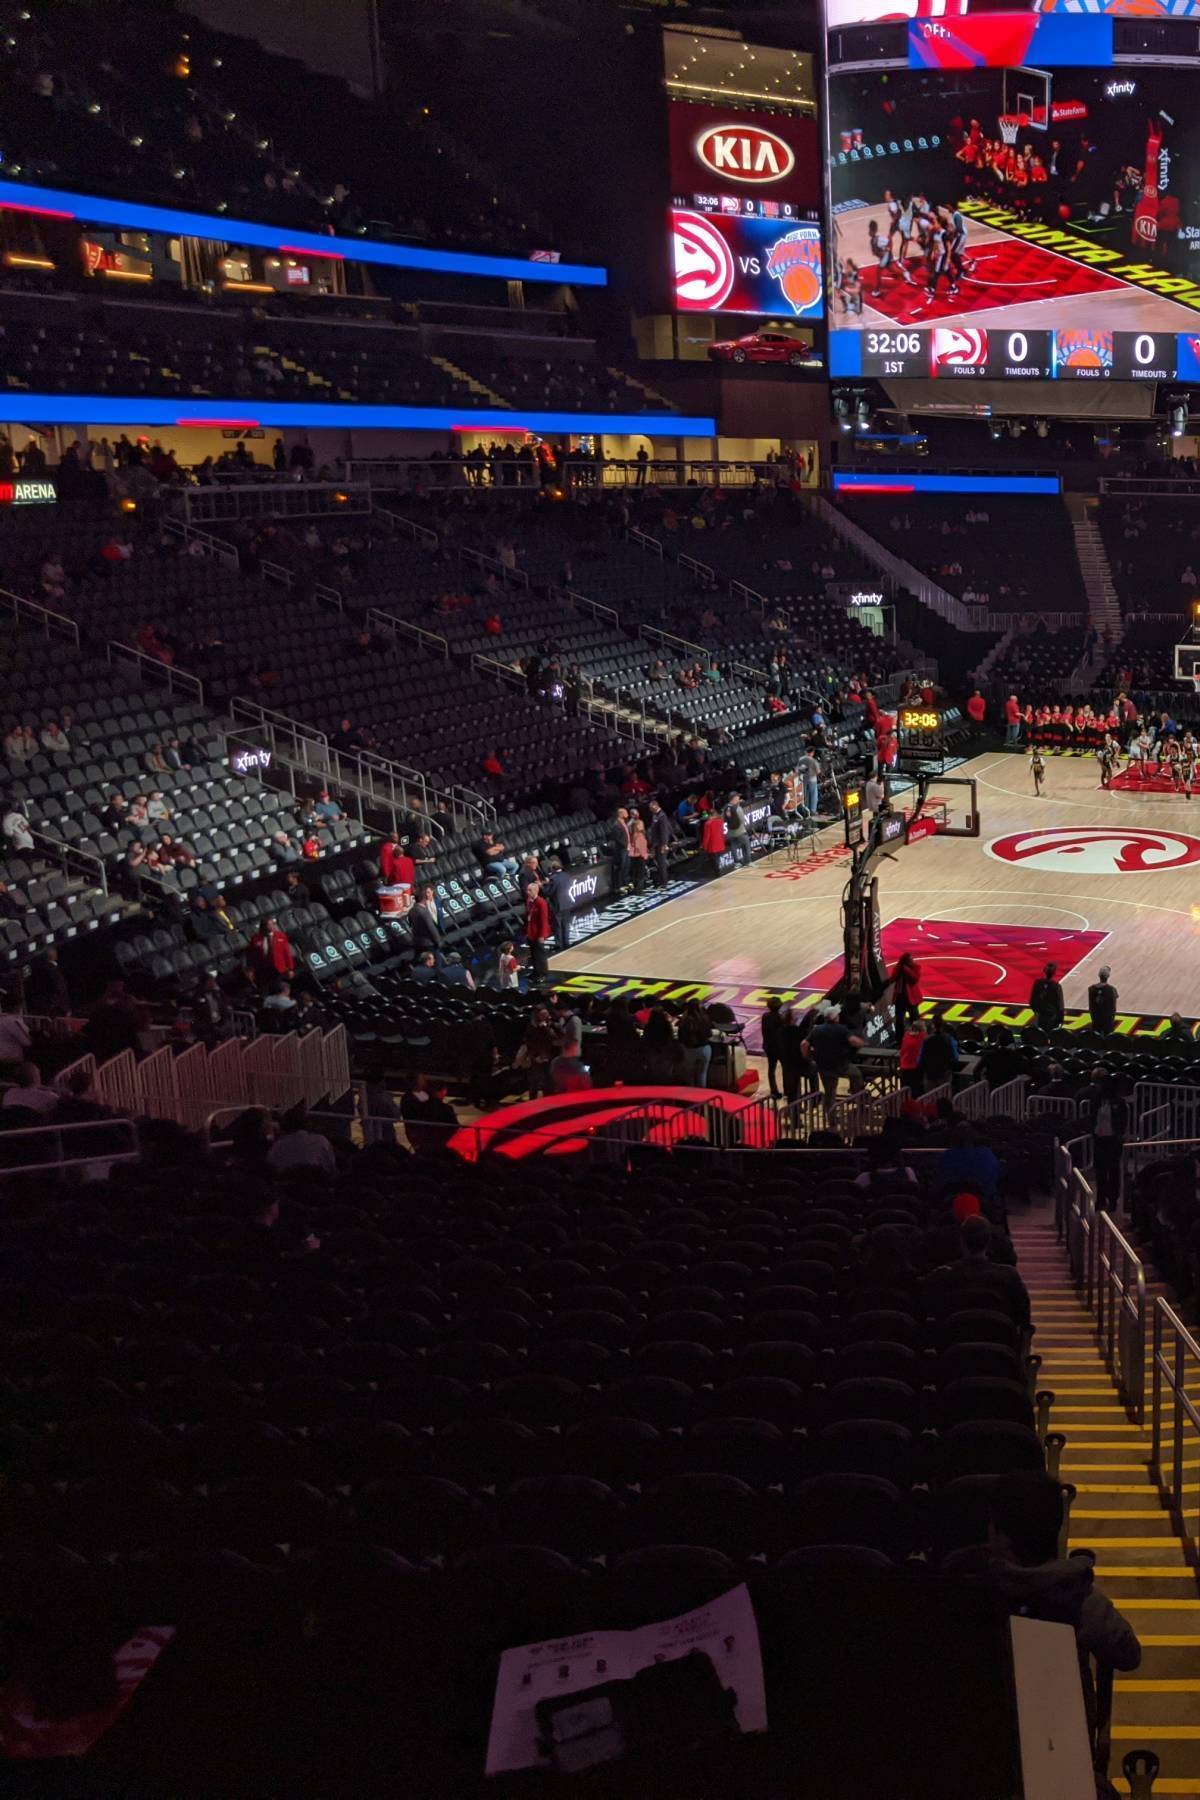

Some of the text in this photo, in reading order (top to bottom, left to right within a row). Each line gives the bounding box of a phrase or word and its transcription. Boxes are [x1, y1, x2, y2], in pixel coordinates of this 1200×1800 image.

[1106, 81, 1136, 97] xfinity
[713, 134, 780, 174] KIA
[1158, 147, 1171, 190] xfinity
[698, 196, 718, 206] 32:06
[957, 200, 1124, 263] ATLANTA
[1140, 219, 1158, 237] KIA
[738, 256, 761, 275] VS
[867, 333, 921, 354] 32:06
[1007, 332, 1028, 362] 0
[1134, 334, 1155, 364] 0
[884, 361, 905, 374] 1ST
[954, 366, 985, 375] FOULS 0
[1005, 367, 1040, 376] TIMEOUTS
[1076, 368, 1110, 377] FOULS 0
[1131, 370, 1167, 378] TIMEOUTS
[15, 483, 57, 499] ARENA
[851, 592, 883, 606] xfinity
[904, 712, 938, 727] 32:06
[237, 750, 272, 772] xfinty
